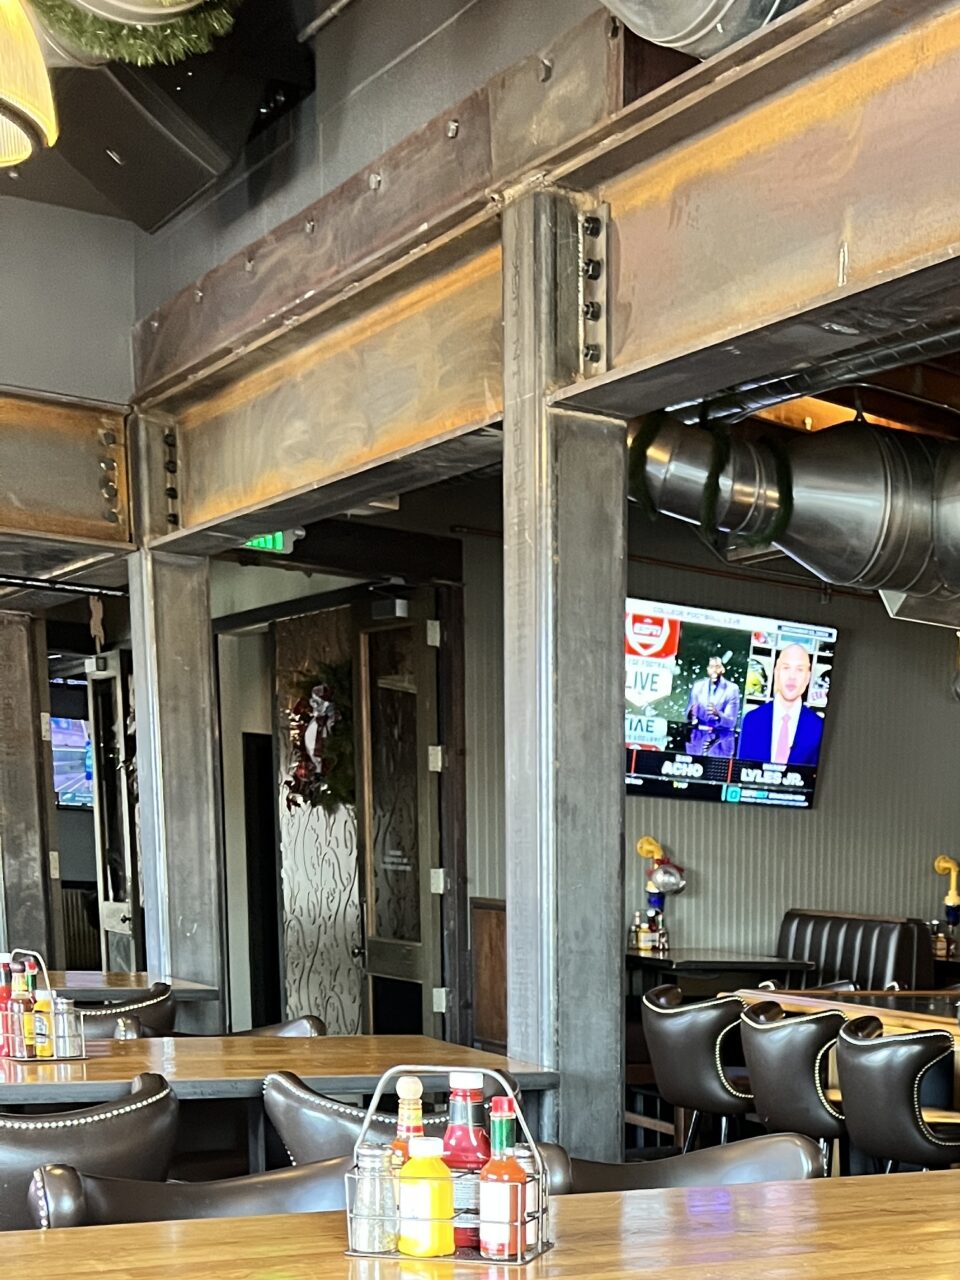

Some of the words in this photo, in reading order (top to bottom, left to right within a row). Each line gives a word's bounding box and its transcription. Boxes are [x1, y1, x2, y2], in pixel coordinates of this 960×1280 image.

[661, 760, 703, 778] ACHO
[740, 767, 782, 785] LYLES
[782, 772, 805, 787] JR.
